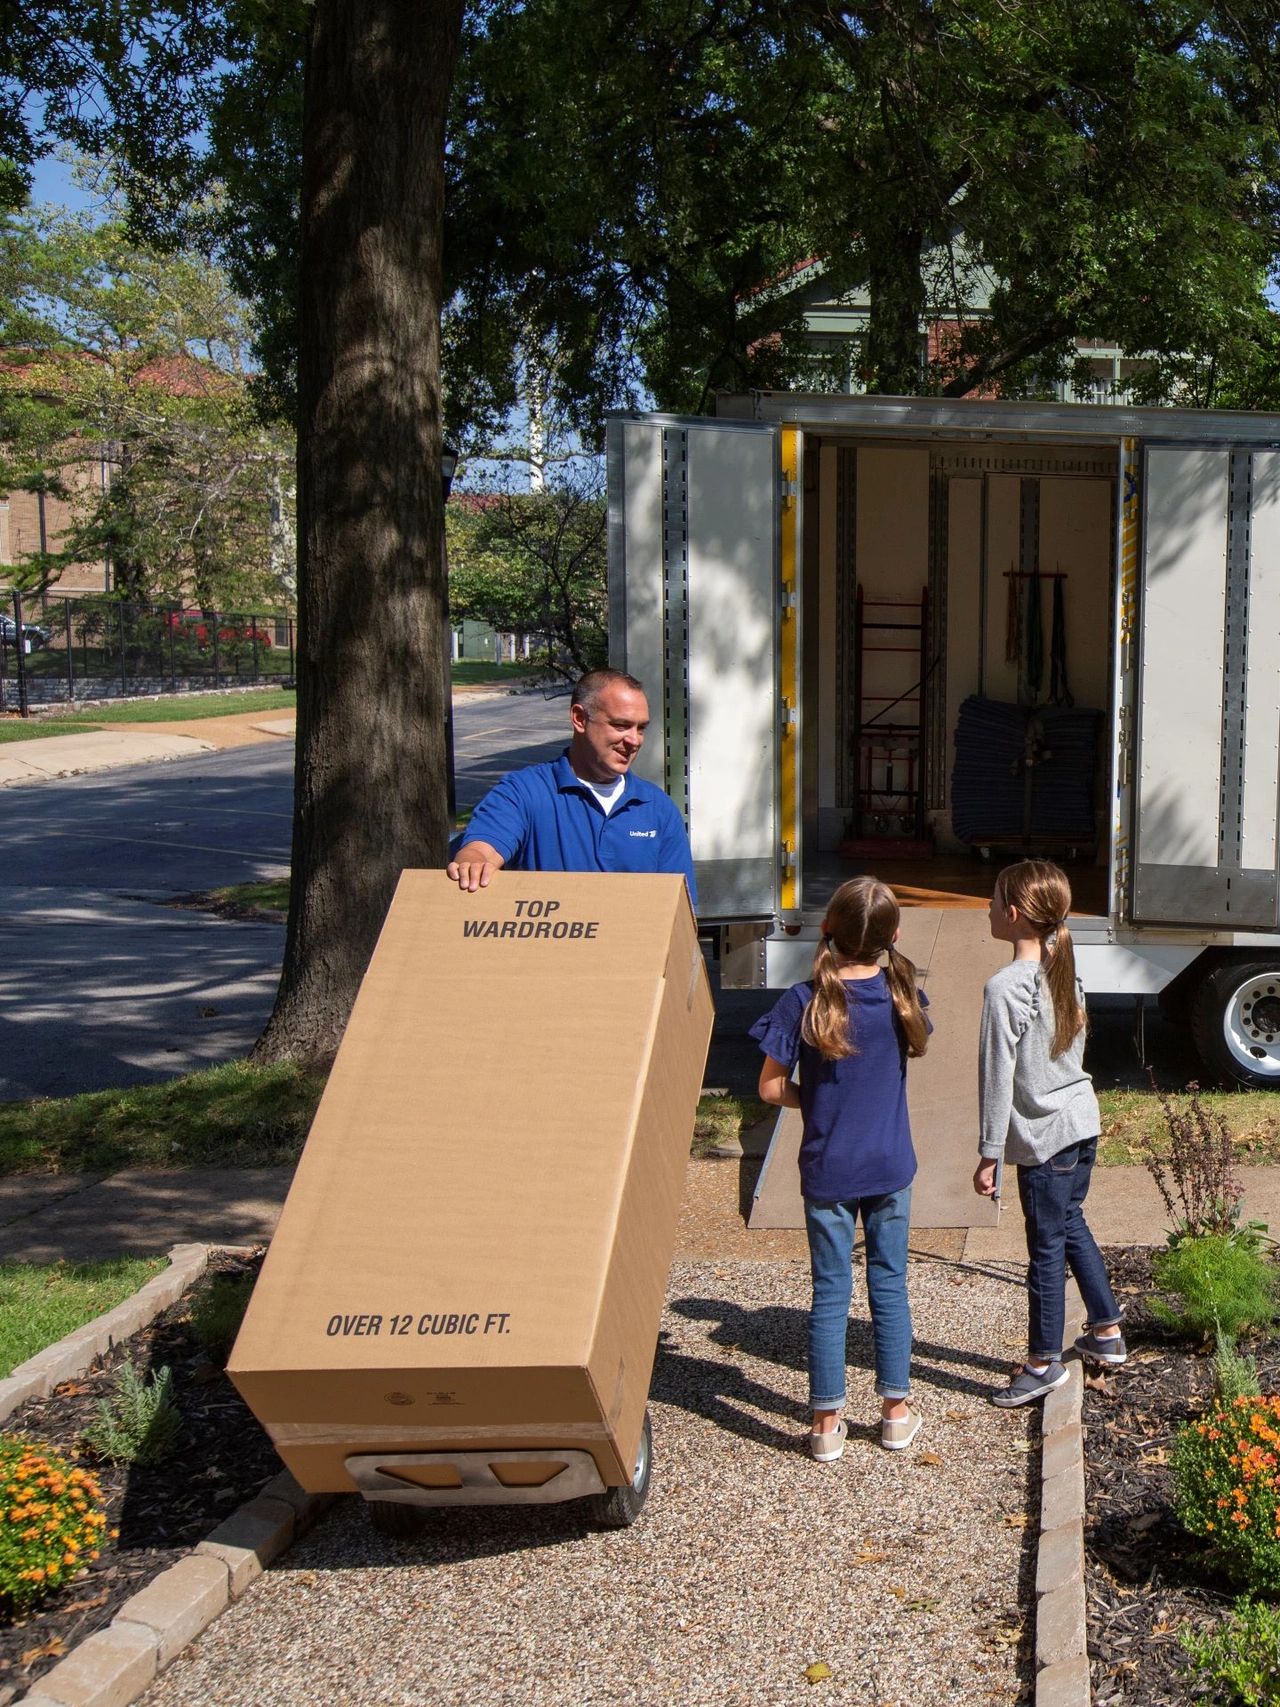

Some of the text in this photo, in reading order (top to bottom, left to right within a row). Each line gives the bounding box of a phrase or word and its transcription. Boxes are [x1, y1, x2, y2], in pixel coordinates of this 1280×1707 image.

[629, 830, 649, 838] United
[514, 900, 560, 918] TOP
[463, 920, 599, 939] WARDROBE
[326, 1313, 511, 1336] OVER 12 CUBIC FT.
